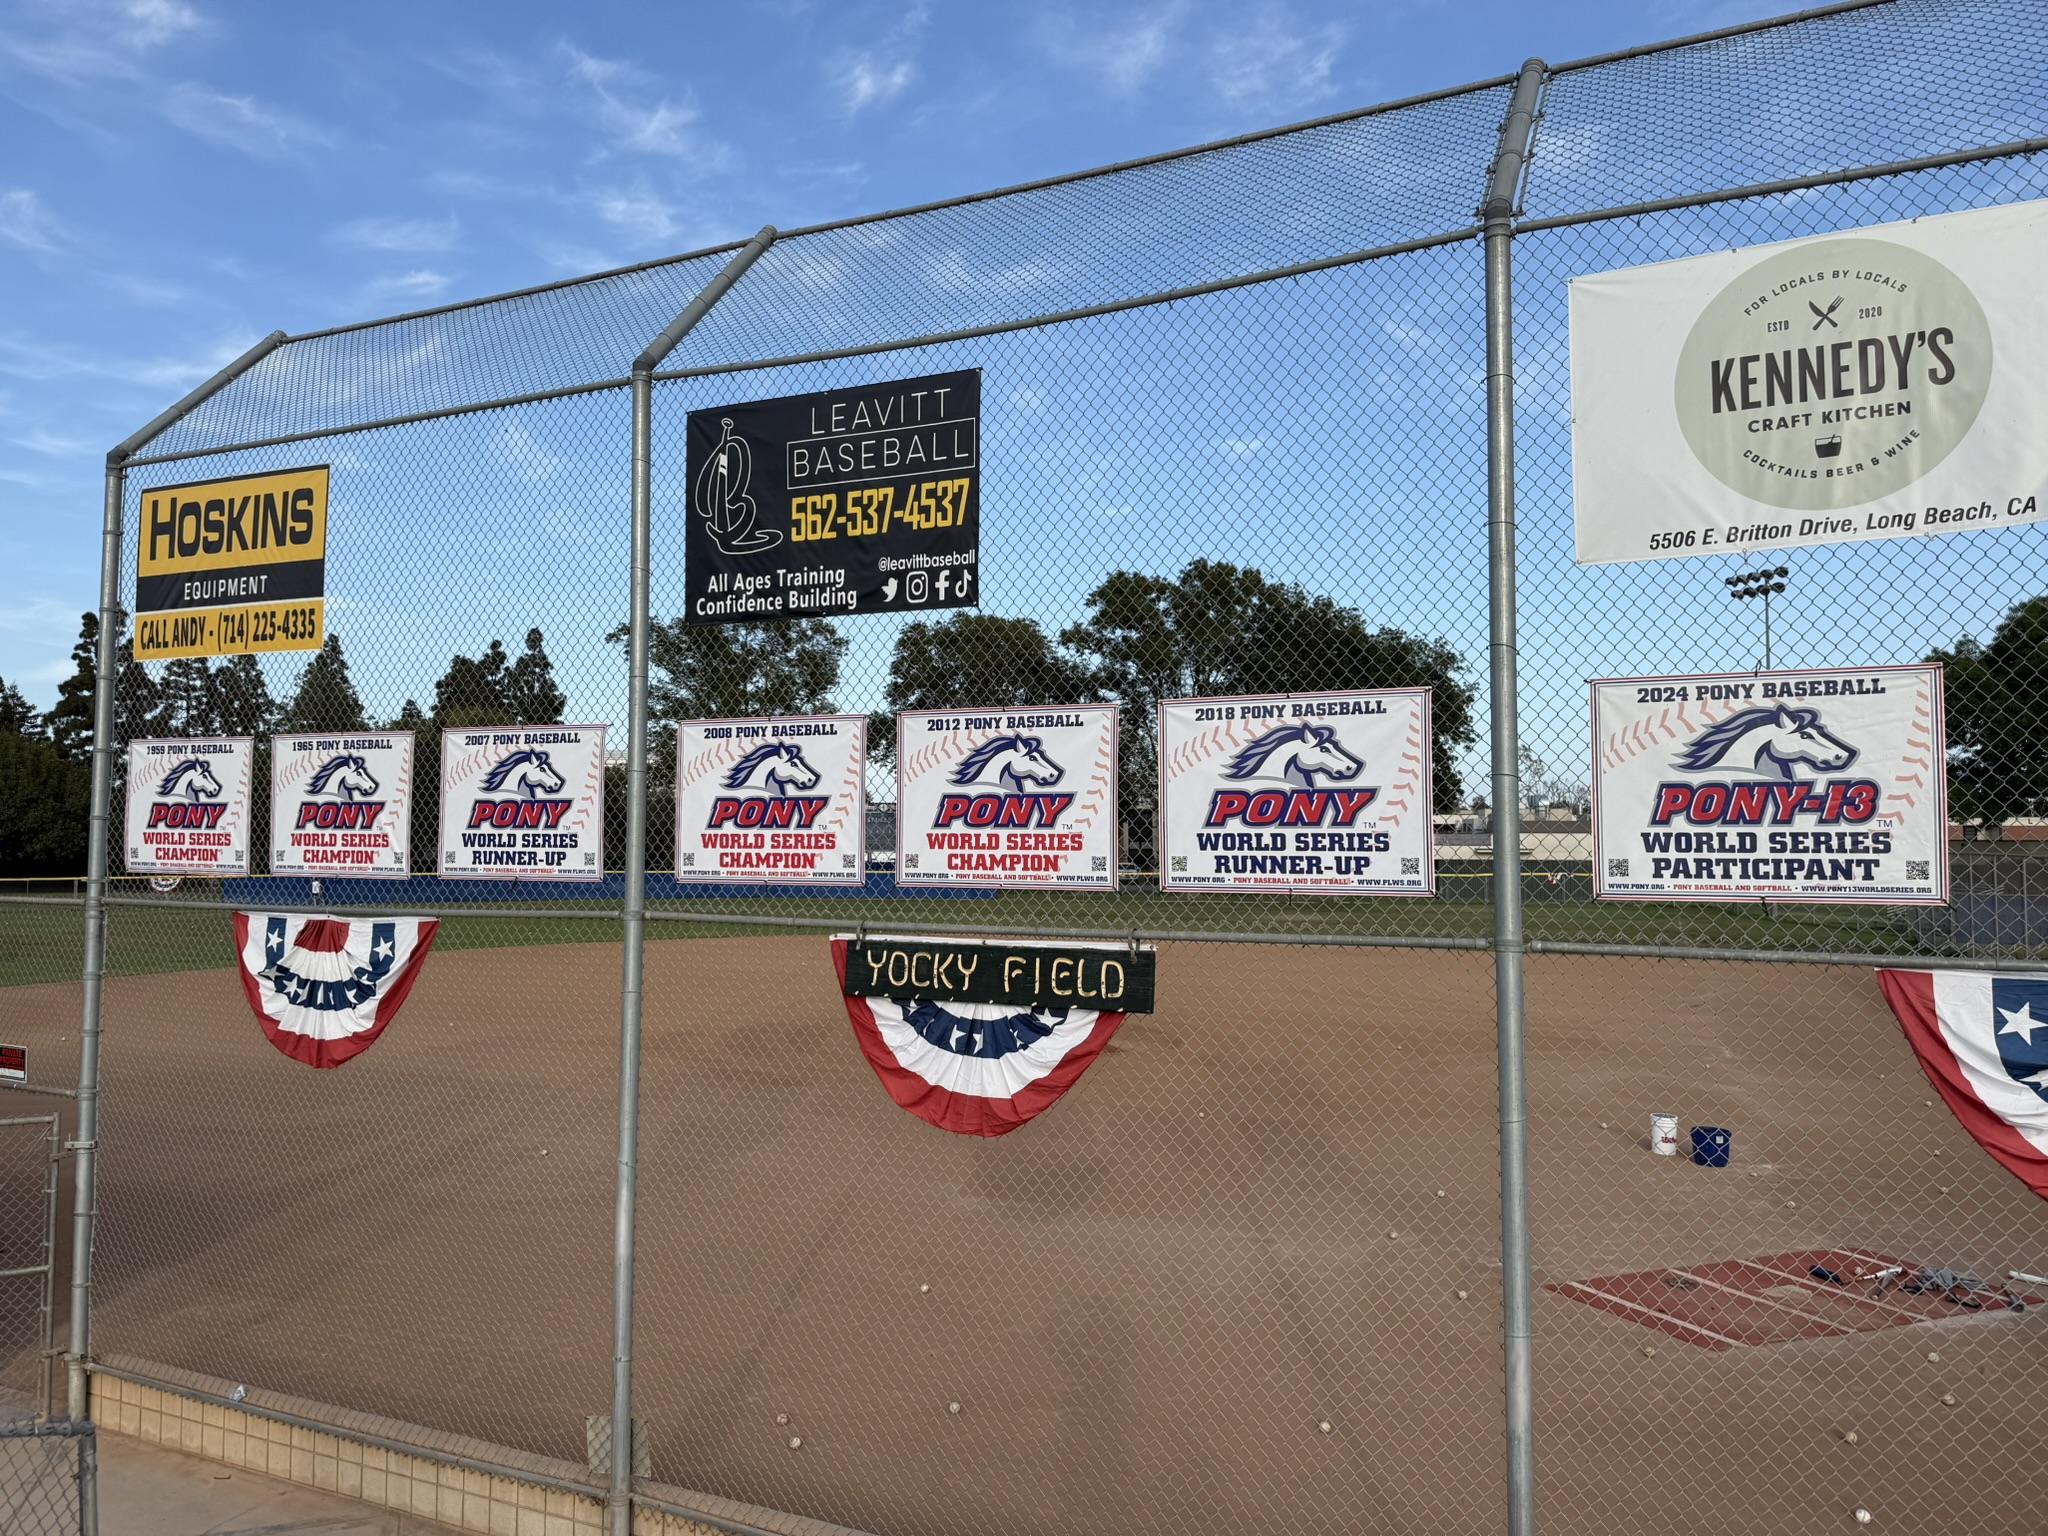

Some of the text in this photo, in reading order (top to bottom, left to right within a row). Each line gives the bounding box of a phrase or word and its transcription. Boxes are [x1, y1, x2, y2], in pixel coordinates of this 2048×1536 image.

[1744, 269, 1908, 316] FOR LOCALS BY LOCALS
[1767, 306, 1882, 333] ESTD 2020
[1711, 326, 1956, 414] KENNEDY'S
[811, 388, 951, 435] LEAVITT
[1747, 400, 1911, 433] CRAFT KITCHEN
[793, 429, 969, 478] BASEBALL
[1743, 429, 1920, 479] COCKTAILS BEER & WINE
[790, 477, 970, 543] 562-537-4537
[149, 487, 314, 561] HOSKINS
[1649, 496, 2037, 551] 5506 E. Britton Drive, Long Beach, CA
[878, 549, 976, 573] @leavittbaseball
[184, 575, 268, 601] EQUIPMENT
[707, 565, 846, 596] All Ages Training
[696, 588, 858, 617] Confidence Building
[140, 619, 169, 651] CALL
[171, 616, 207, 647] ANDY
[217, 610, 250, 652] (714)
[252, 608, 316, 642] 225-4335
[1636, 678, 1886, 703] 2024 PONY BASEBALL
[927, 714, 1084, 731] 2012 PONY BASEBALL
[1195, 700, 1387, 721] 2018 PONY BASEBALL
[465, 732, 581, 745] 2007 PONY BASEBALL
[704, 724, 838, 739] 2008 PONY BASEBALL
[147, 744, 234, 755] 1959 PONY BASEBALL
[292, 739, 392, 751] 1965 PONY BASEBALL
[466, 798, 575, 830] PONY
[705, 795, 832, 831] PONY
[931, 791, 1078, 830] PONY
[1202, 786, 1382, 829] PONY
[1648, 777, 1893, 828] PONY-13 TM
[147, 802, 228, 829] PONY
[295, 800, 386, 830] PONY
[143, 832, 232, 846] WORLD SERIES
[291, 833, 389, 848] WORLD SERIES
[462, 833, 578, 848] WORLD SERIES
[701, 833, 837, 850] WORLD SERIES
[926, 833, 1083, 851] WORLD SERIES
[1196, 832, 1390, 853] WORLD SERIES
[1640, 832, 1892, 854] WORLD SERIES
[155, 847, 219, 861] CHAMPION
[303, 849, 375, 864] CHAMPION
[472, 850, 567, 866] RUNNER-UP
[719, 852, 816, 869] CHAMPION
[947, 853, 1060, 872] CHAMPION
[1214, 855, 1371, 876] RUNNER-UP
[1652, 858, 1881, 882] PARTICIPANT
[1357, 879, 1422, 887] WWW.PLWS.ORG
[1801, 886, 1932, 894] WWW.PONY13WORLDSERIES.ORG
[867, 949, 1125, 1000] YOCKY FIELD
